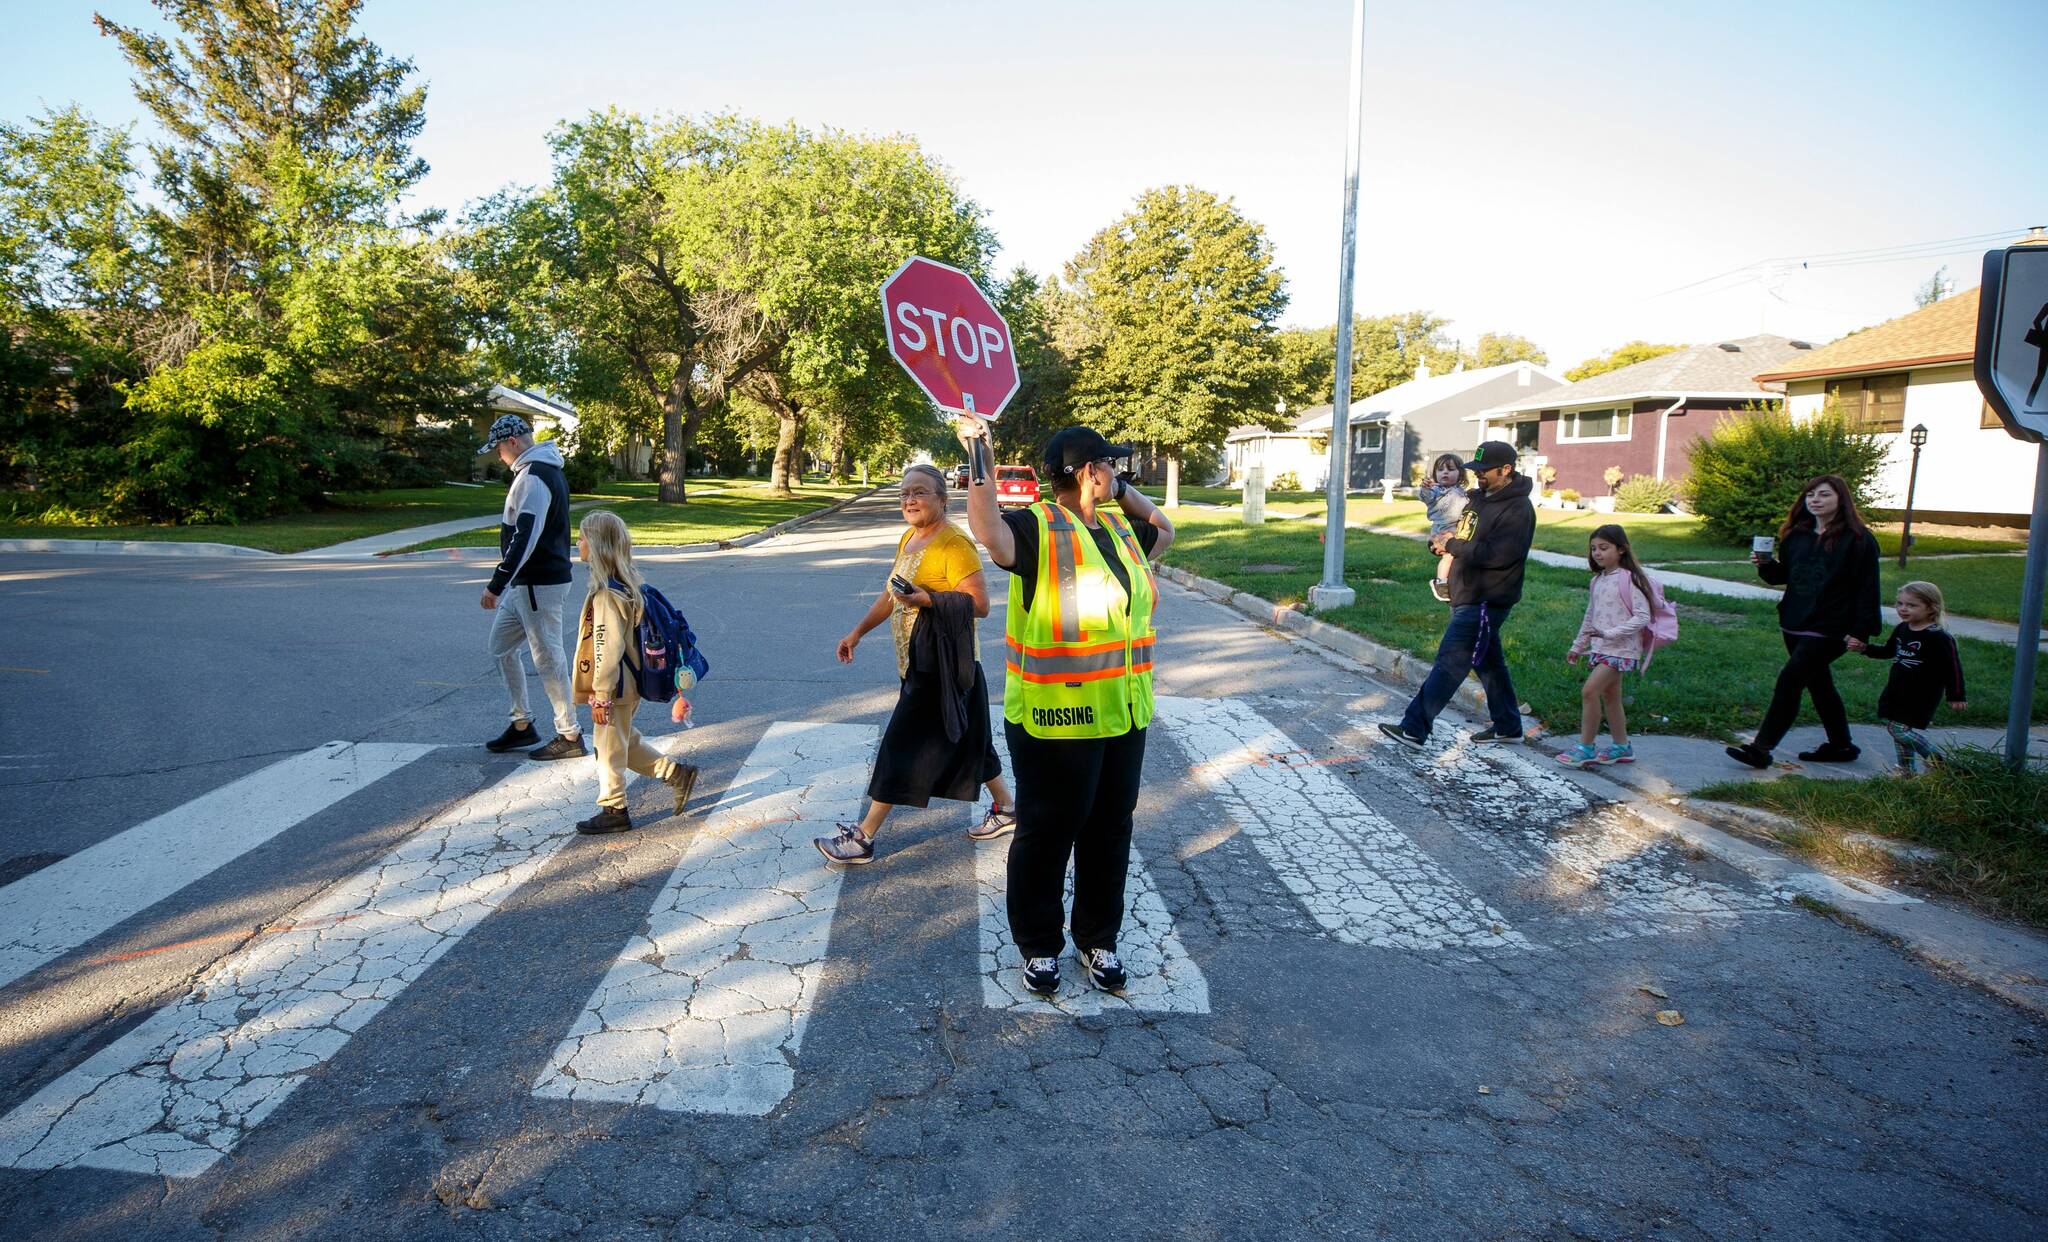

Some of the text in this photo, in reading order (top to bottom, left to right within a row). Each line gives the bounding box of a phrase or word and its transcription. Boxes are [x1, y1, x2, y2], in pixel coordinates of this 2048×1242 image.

[896, 301, 1004, 369] STOP
[596, 624, 605, 652] Hello
[1032, 705, 1094, 727] CROSSING
